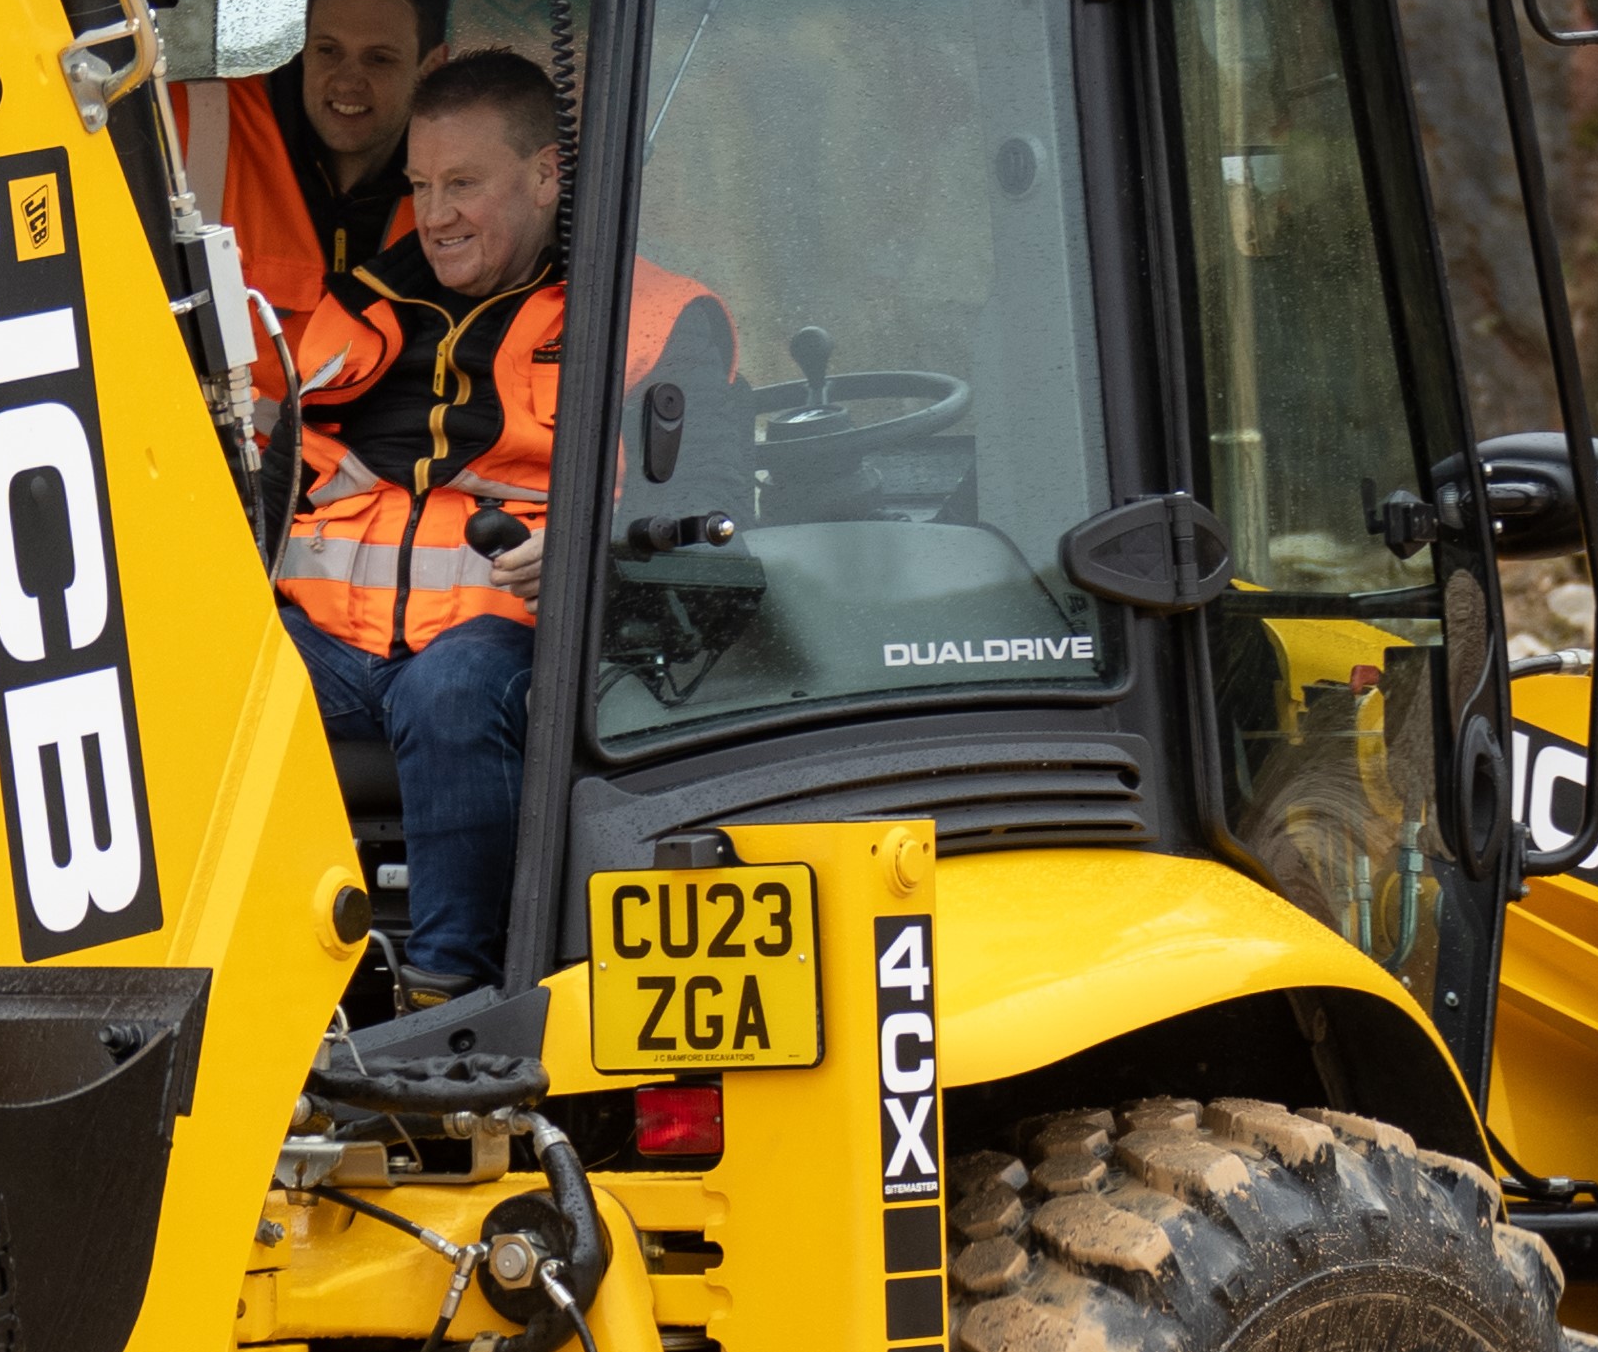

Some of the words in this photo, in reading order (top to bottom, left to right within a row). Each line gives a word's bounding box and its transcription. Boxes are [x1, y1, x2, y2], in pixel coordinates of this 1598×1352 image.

[24, 196, 48, 244] JCB
[883, 636, 1095, 666] DUALDRIVE
[611, 881, 794, 960] CU23
[637, 975, 772, 1052] ZGA
[667, 1052, 703, 1062] BAMFORD
[705, 1052, 755, 1061] EXCAVATORS
[878, 925, 937, 1177] 4CX
[884, 1181, 938, 1194] SITEMASTER
